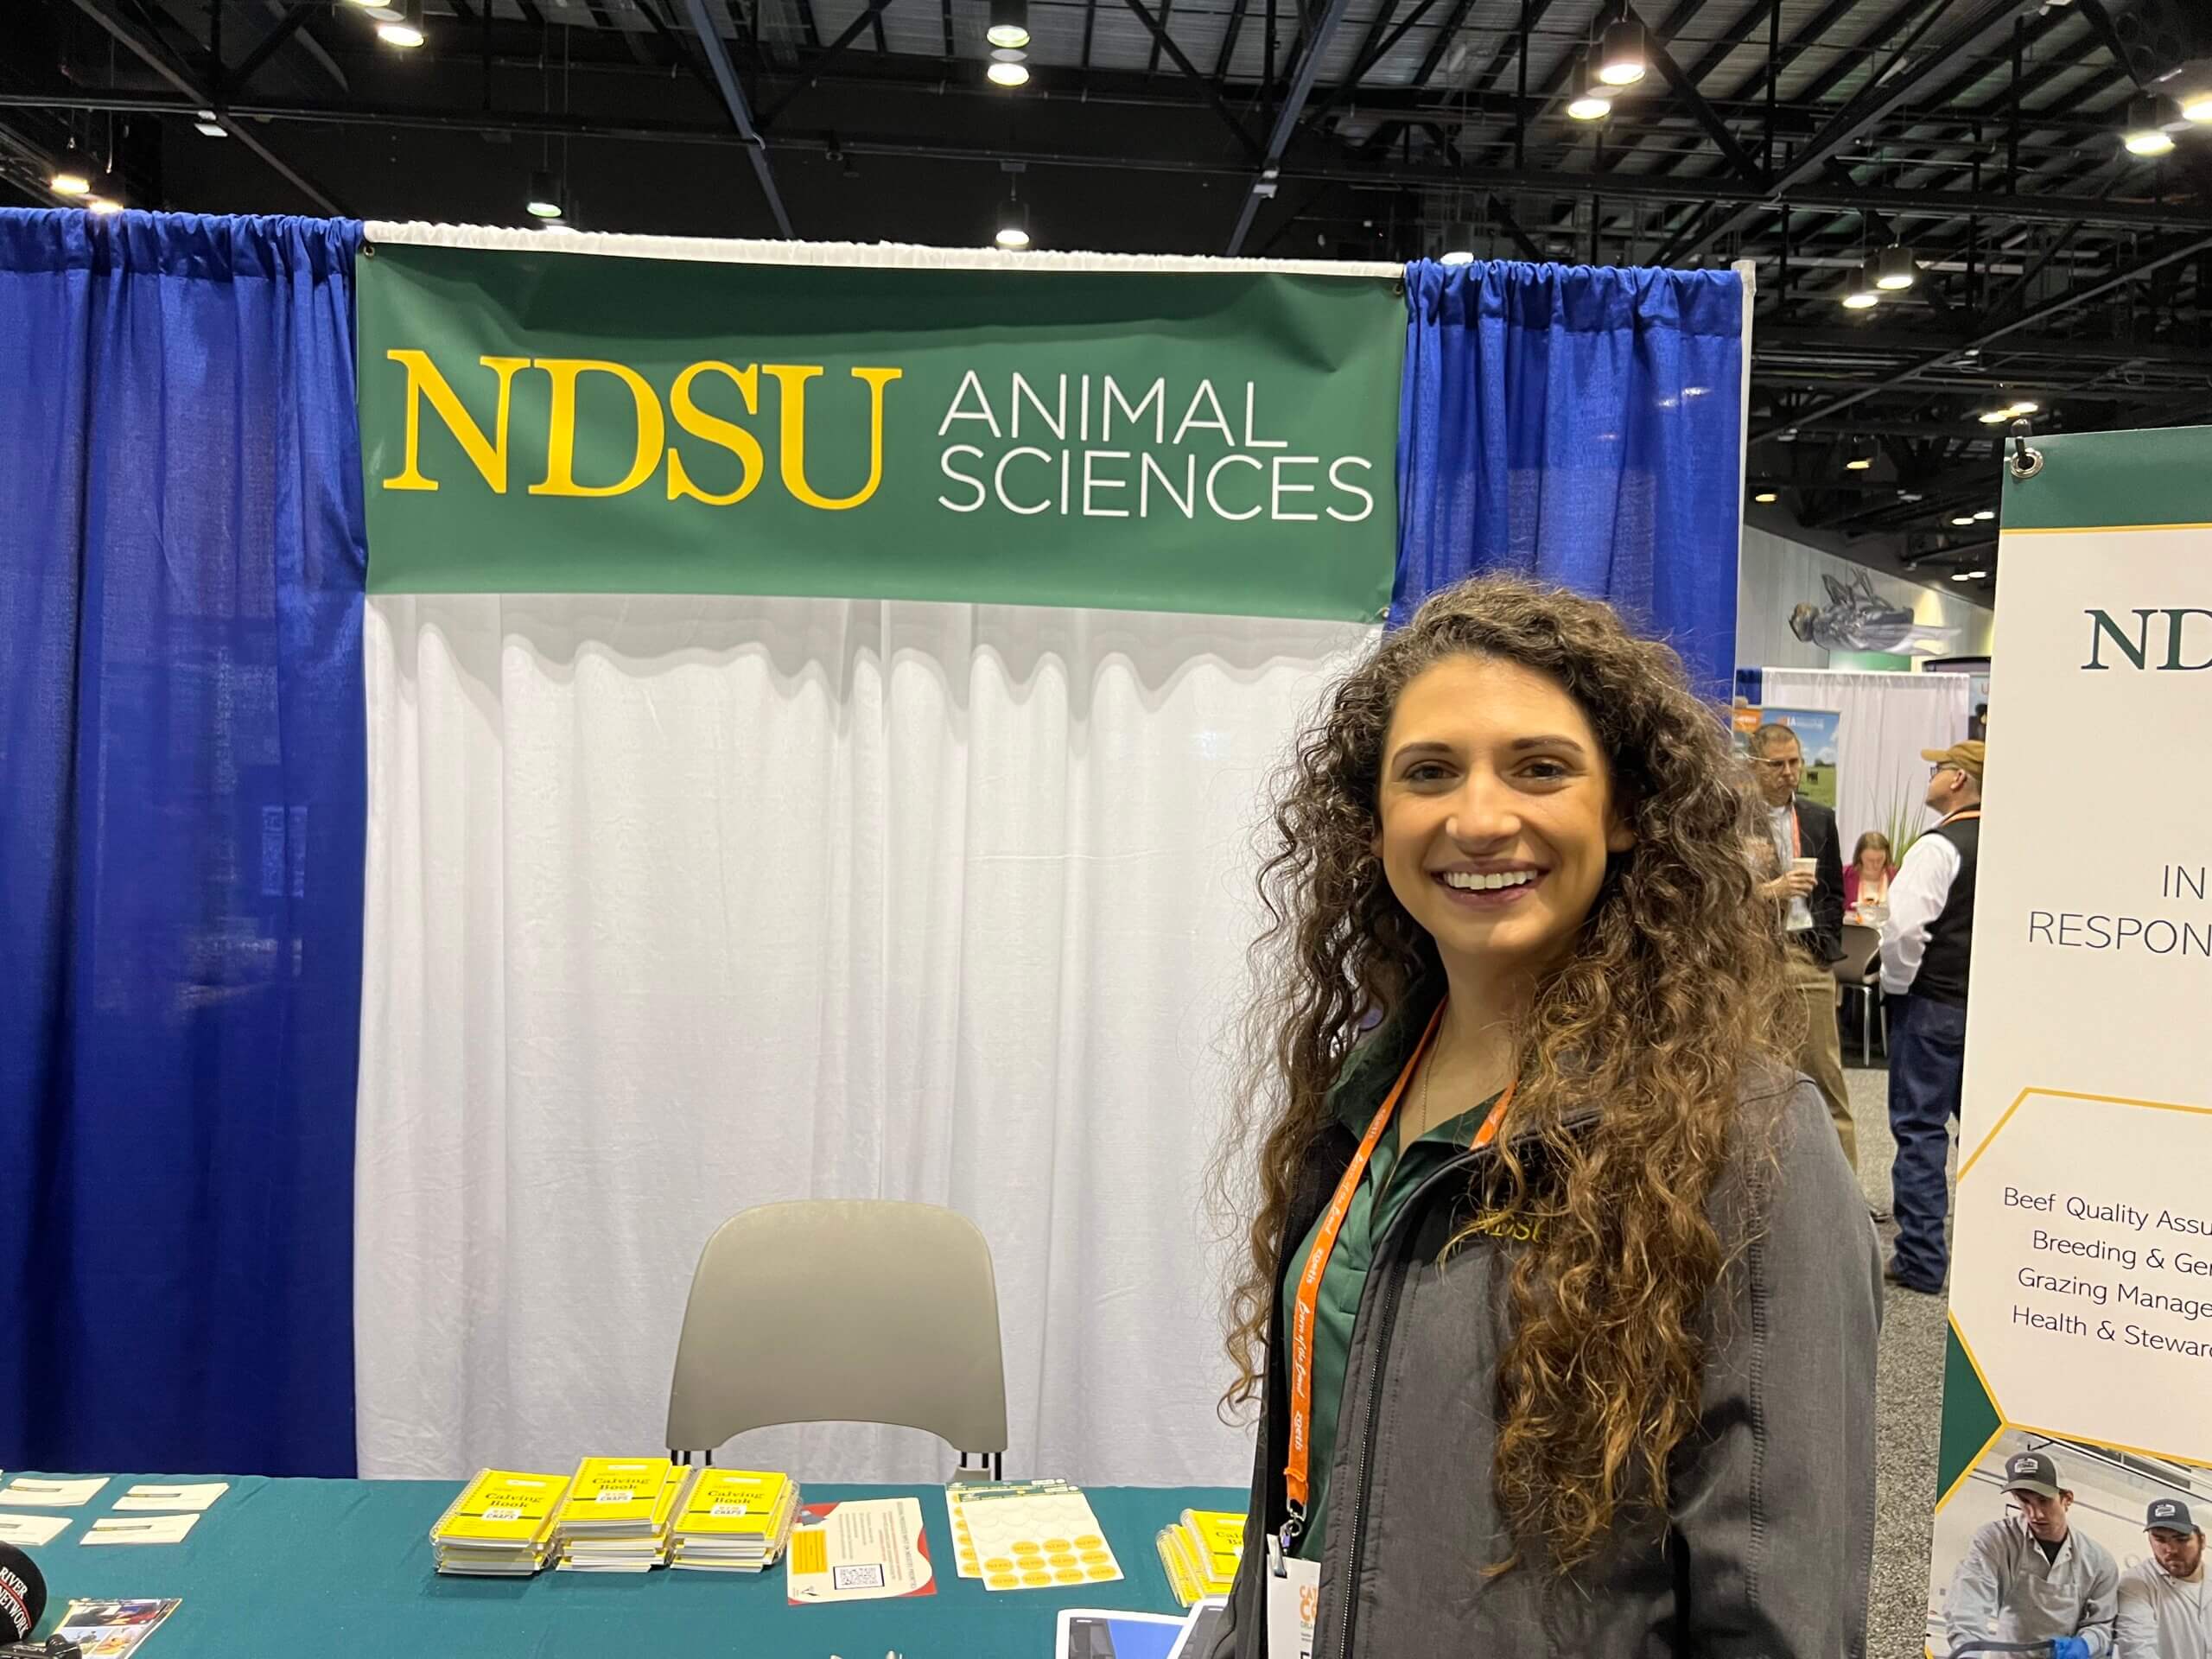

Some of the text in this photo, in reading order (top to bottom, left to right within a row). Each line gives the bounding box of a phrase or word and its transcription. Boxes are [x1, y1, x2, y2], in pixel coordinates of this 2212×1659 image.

[383, 348, 903, 512] NDSU
[938, 370, 1288, 449] ANIMAL
[938, 446, 1375, 524] SCIENCES
[2081, 608, 2212, 671] ND
[2164, 864, 2205, 899] IN
[2029, 911, 2212, 957] RESPON
[2004, 1186, 2212, 1236] Beef Quality Assu
[2032, 1230, 2137, 1270] Breeding
[2145, 1249, 2165, 1269] &
[2018, 1267, 2212, 1321] Grazing Manage
[2012, 1305, 2088, 1337] Health
[2096, 1320, 2116, 1342] &
[485, 1492, 545, 1503] Calving
[0, 1566, 29, 1600] RIVER
